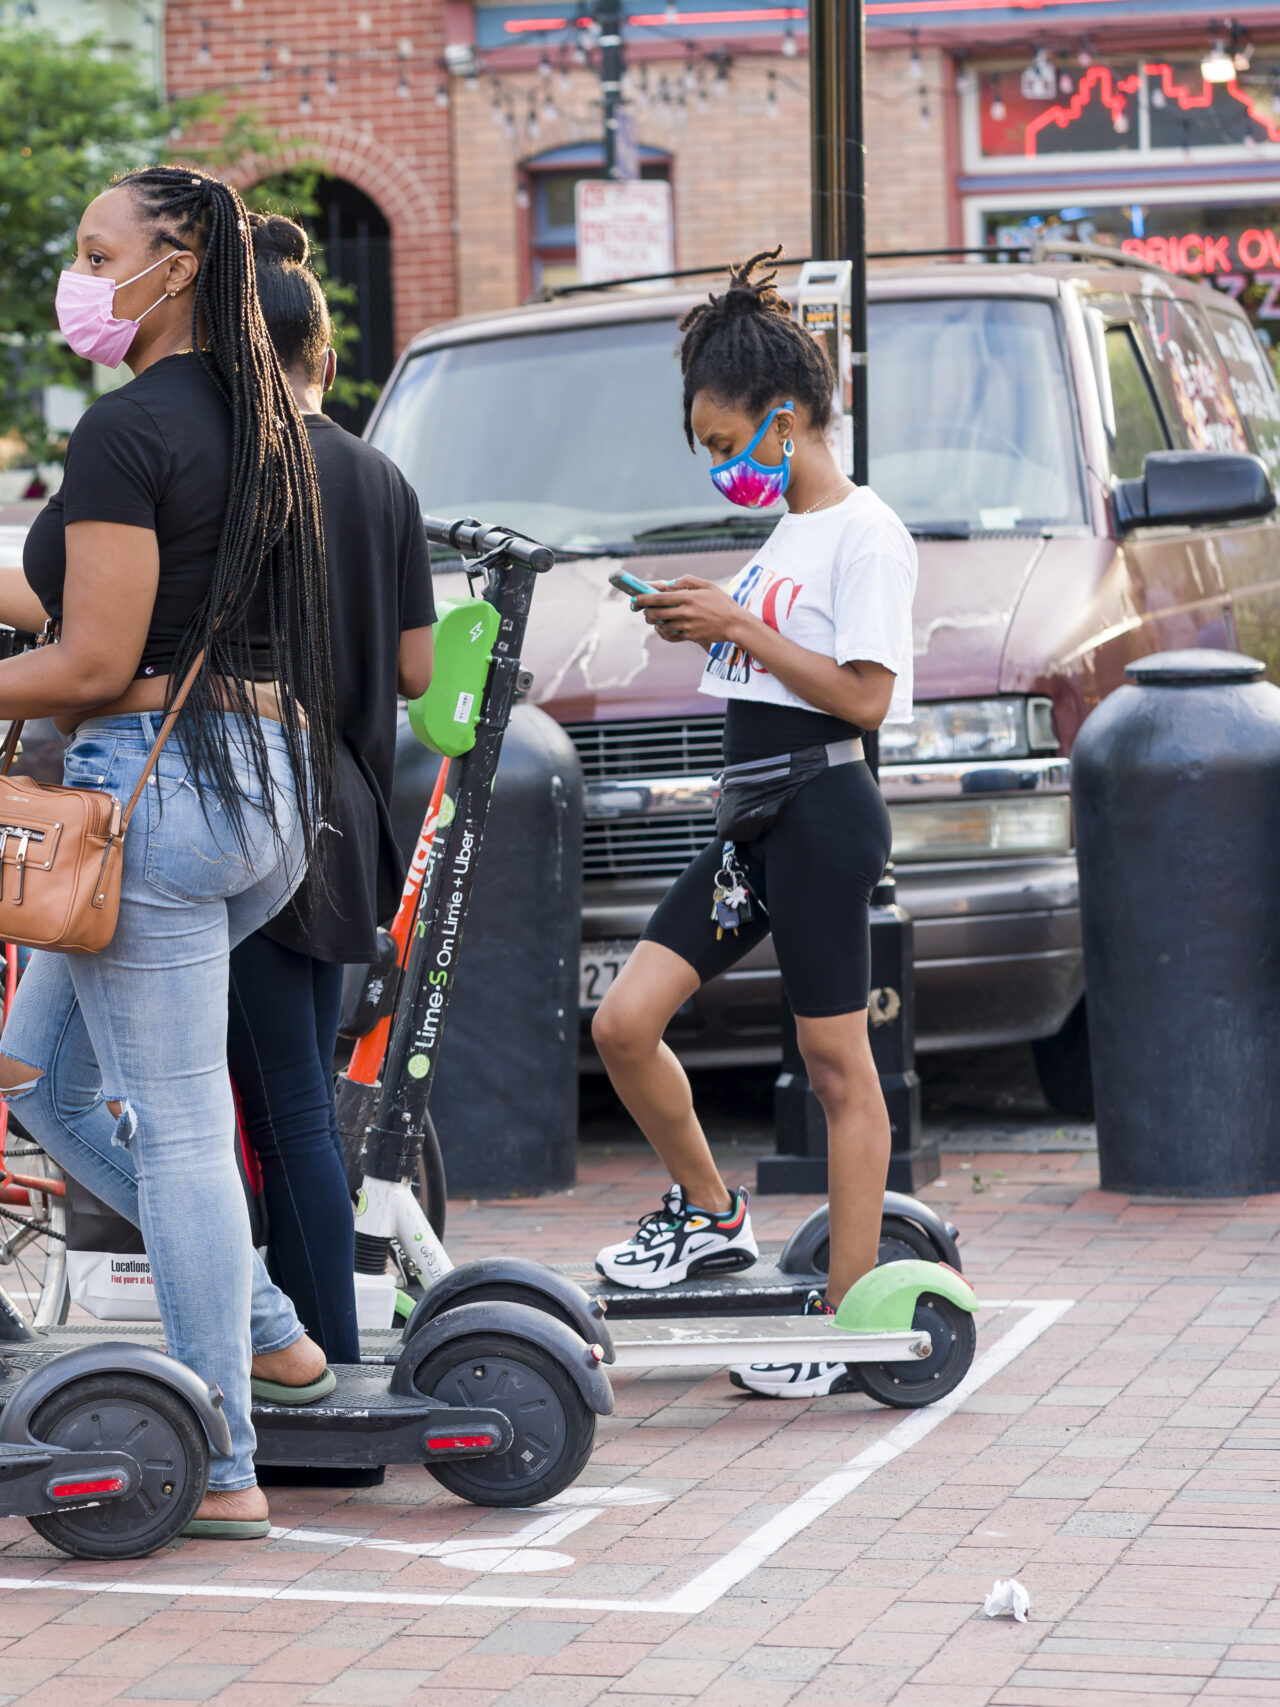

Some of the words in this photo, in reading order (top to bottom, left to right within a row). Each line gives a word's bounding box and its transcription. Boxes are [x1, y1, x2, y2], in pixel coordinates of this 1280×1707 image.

[453, 829, 474, 874] Uber
[441, 891, 463, 935] Lime
[436, 938, 454, 967] On
[111, 1260, 150, 1273] Locations
[111, 1275, 122, 1283] Find
[123, 1276, 139, 1285] yours
